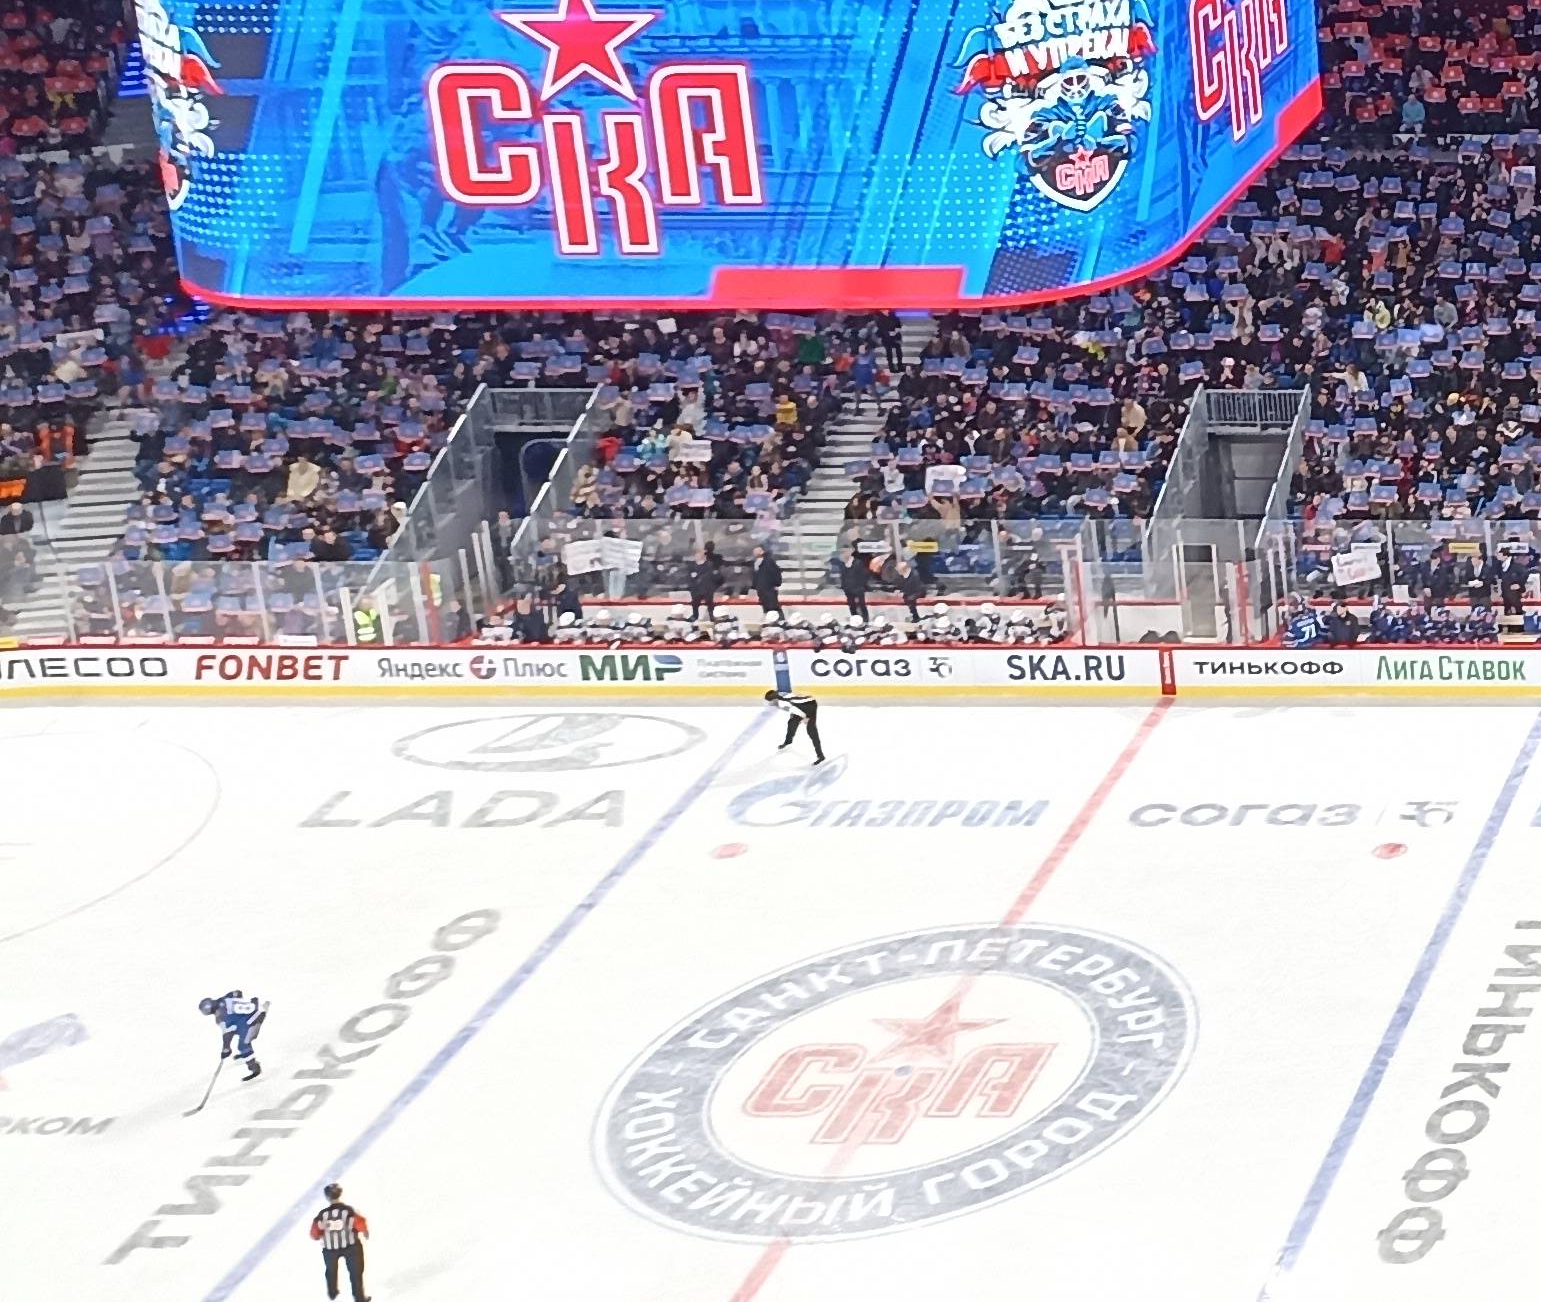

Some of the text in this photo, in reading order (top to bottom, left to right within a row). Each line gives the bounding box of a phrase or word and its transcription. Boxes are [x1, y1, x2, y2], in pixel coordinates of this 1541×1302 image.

[428, 60, 764, 256] СКА
[194, 655, 350, 681] FONBET
[377, 657, 569, 681] Яндекс Плюс
[579, 655, 684, 682] МИР
[1006, 655, 1126, 682] SKA.RU
[297, 789, 627, 829] LADA
[686, 935, 1169, 1053] САНКТ-ПЕТЕРБУРГ
[742, 1041, 1060, 1146] СКА
[624, 1086, 1138, 1228] ХОККЕЙНЫЙ ГОРОД
